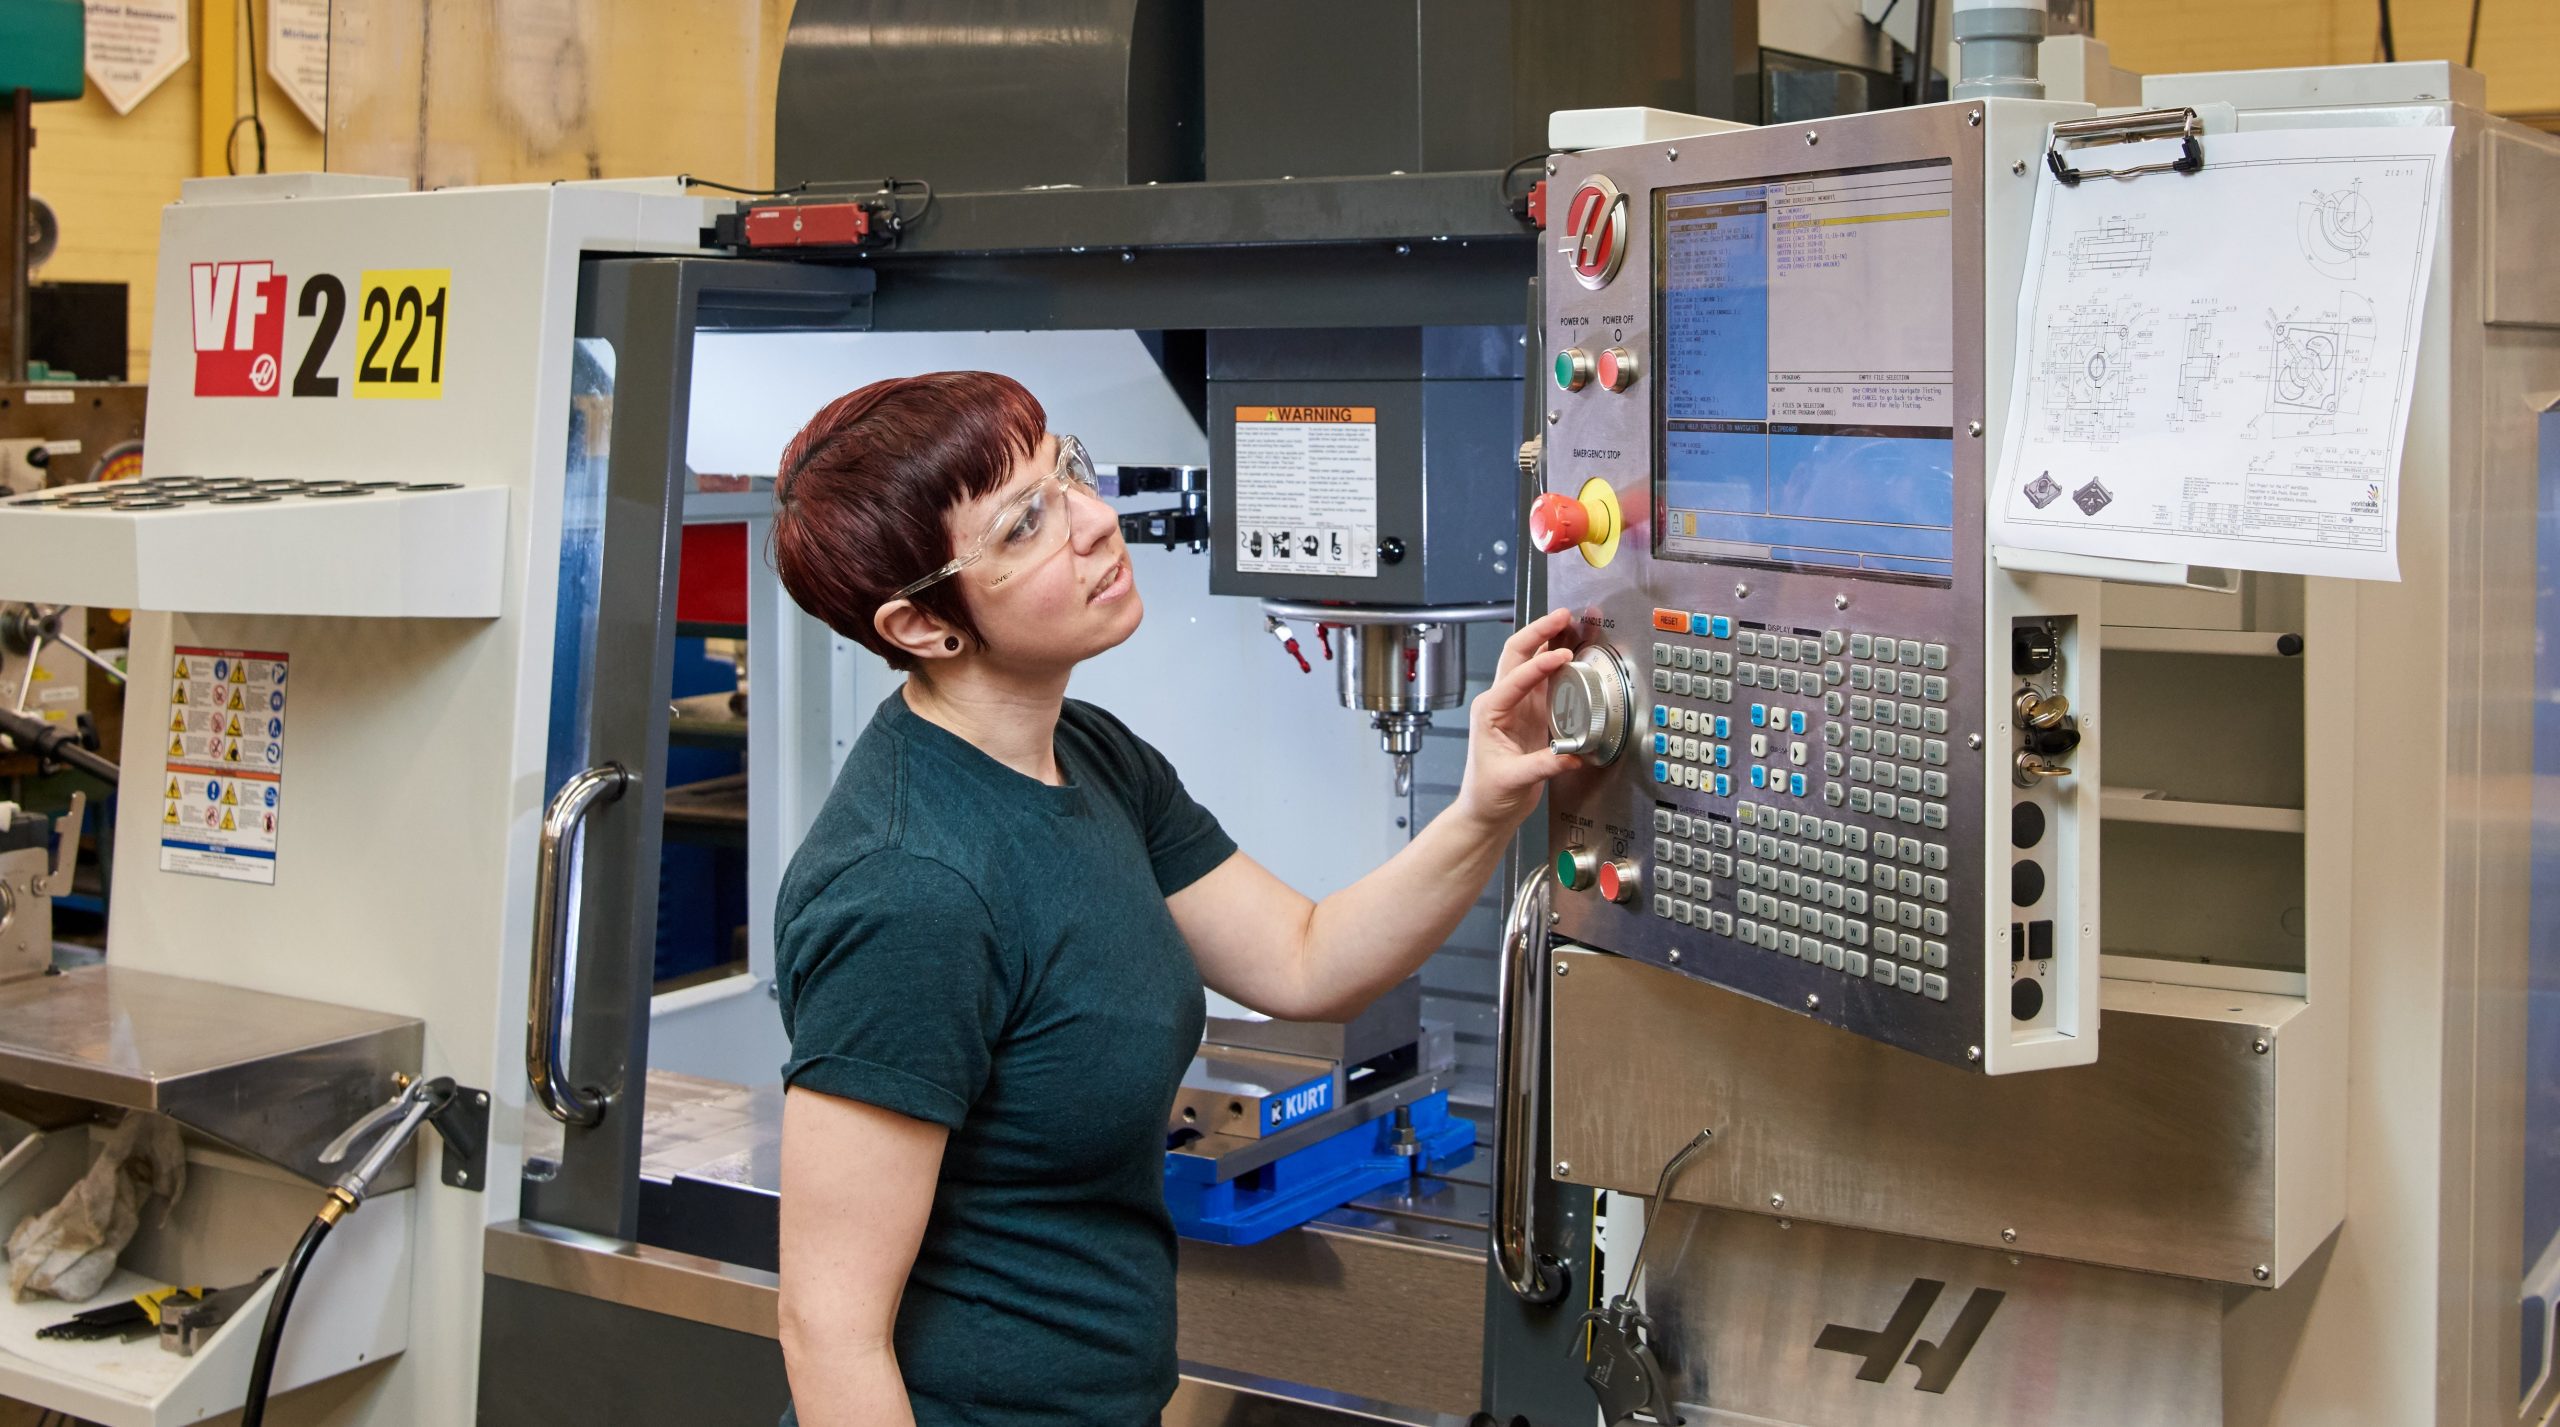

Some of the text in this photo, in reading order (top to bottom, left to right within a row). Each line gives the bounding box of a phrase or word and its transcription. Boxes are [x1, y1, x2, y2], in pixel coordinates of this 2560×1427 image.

[1560, 316, 1589, 326] POWER ON
[1602, 315, 1634, 324] POWER OFF
[191, 262, 346, 397] VF 2
[359, 286, 446, 383] 221
[1922, 387, 1942, 395] listing
[1278, 408, 1352, 422] WARNING
[1573, 448, 1621, 460] EMERGENCY STOP
[1602, 619, 1616, 628] JOG
[1660, 616, 1678, 626] RESET
[1768, 624, 1790, 634] DISPLAY
[1656, 650, 1664, 658] F1
[1676, 653, 1682, 662] F2
[1696, 656, 1702, 664] F3
[1716, 660, 1722, 668] F4
[1874, 967, 1890, 977] CANCEL
[1926, 982, 1940, 992] ENTER
[1286, 1083, 1328, 1120] KURT
